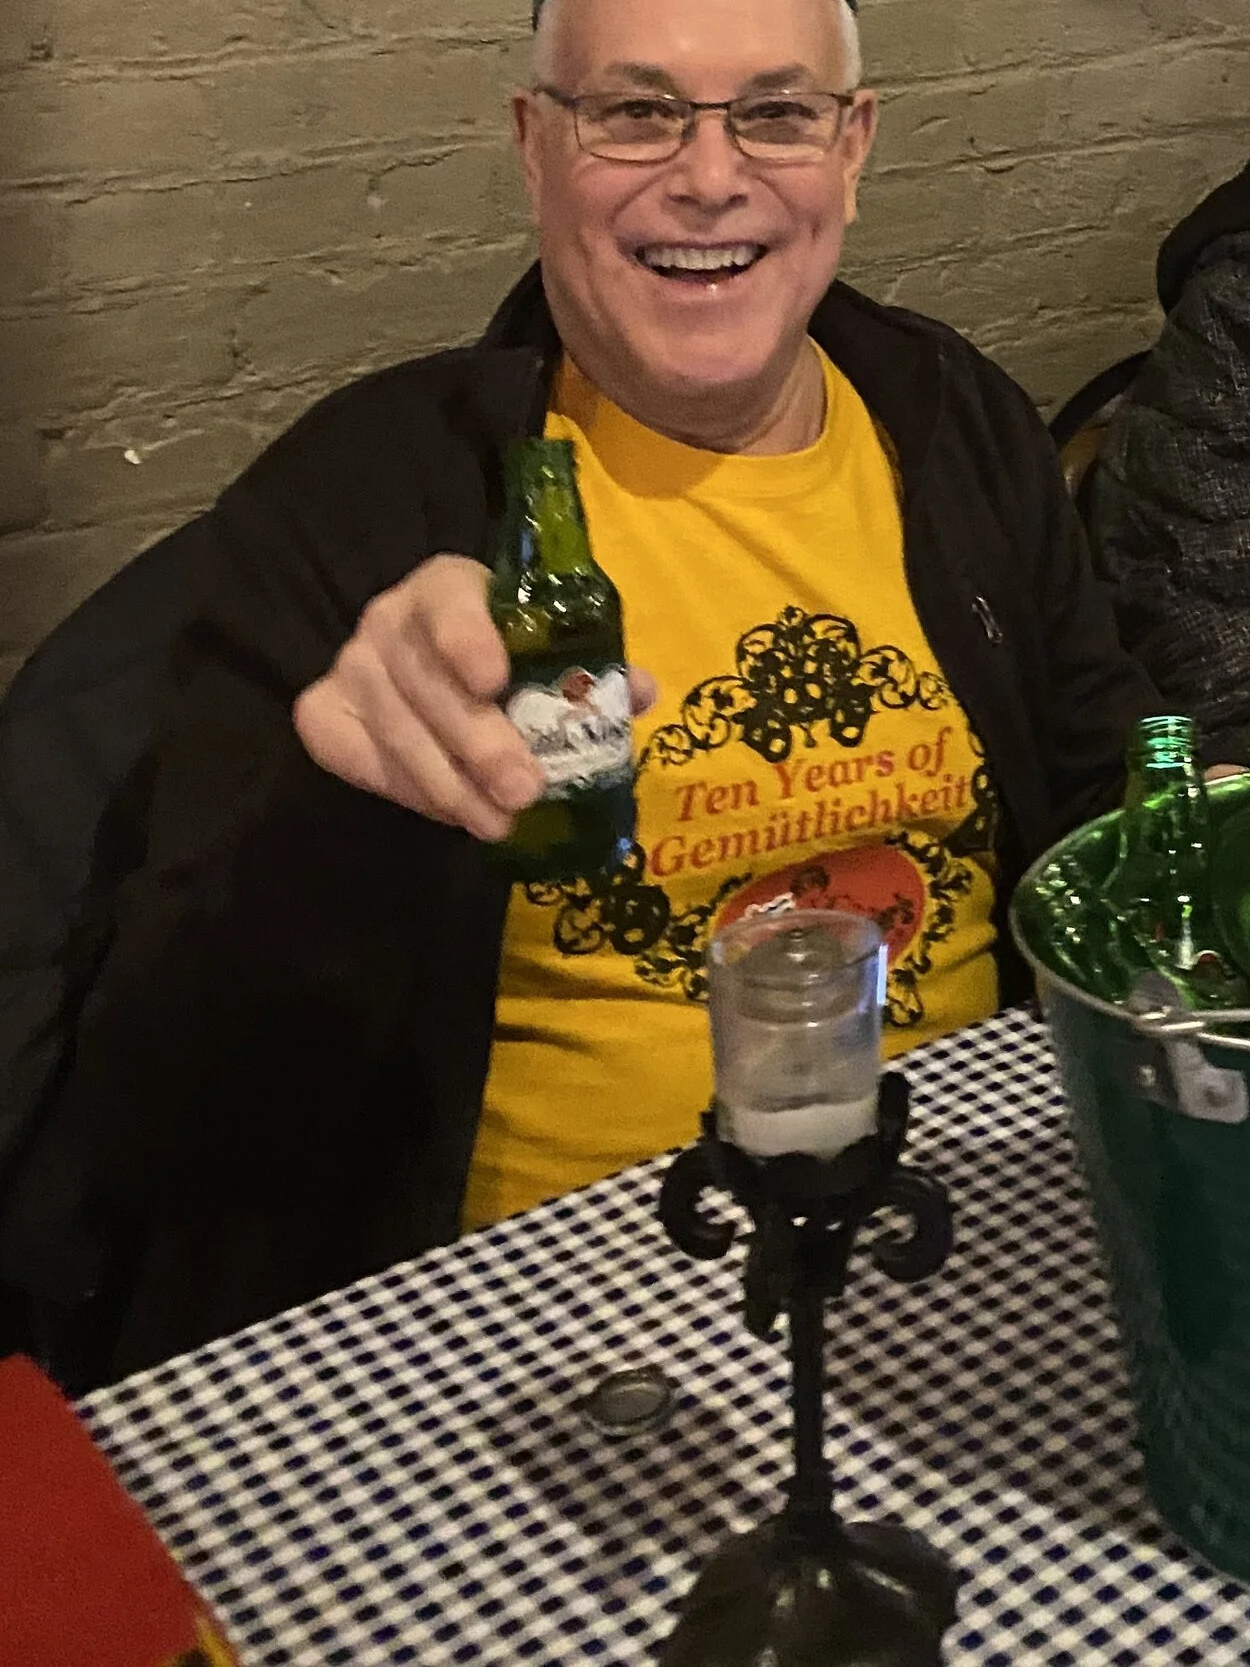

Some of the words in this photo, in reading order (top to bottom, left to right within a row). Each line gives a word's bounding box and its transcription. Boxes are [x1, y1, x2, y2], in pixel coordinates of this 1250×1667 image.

[650, 771, 972, 878] Gemütlichkeit
[676, 779, 761, 822] Ten
[773, 748, 896, 799] Years
[906, 725, 953, 777] of
